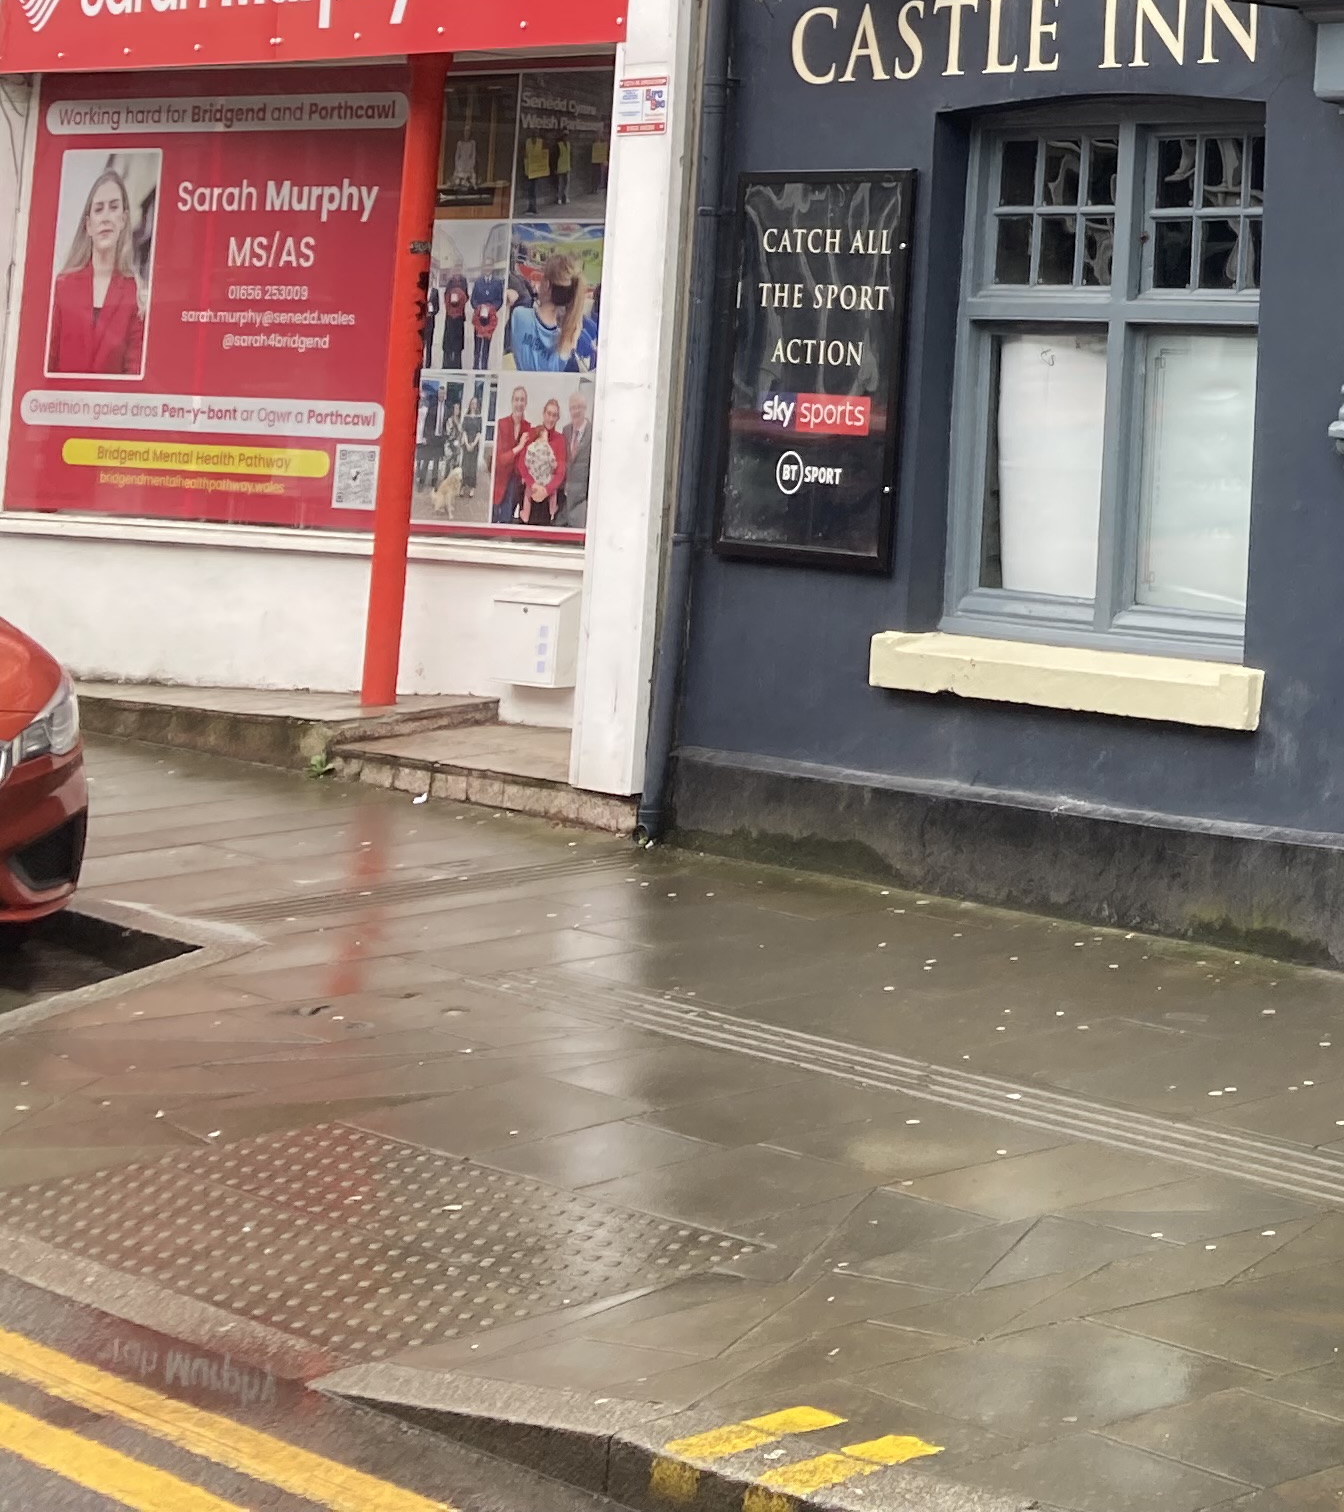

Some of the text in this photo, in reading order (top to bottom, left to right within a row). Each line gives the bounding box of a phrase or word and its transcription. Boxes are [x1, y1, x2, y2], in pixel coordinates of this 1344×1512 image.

[59, 100, 396, 130] Working hard for Bridgend and Porthcawl
[177, 178, 379, 222] Sarah Murphy
[227, 231, 315, 267] MS/AS
[763, 228, 892, 255] CATCH ALL
[228, 286, 261, 300] 01656
[758, 283, 889, 311] THE SPORT
[771, 338, 864, 366] ACTION
[161, 404, 237, 424] Pen-y-bont
[240, 409, 254, 421] ar
[257, 408, 291, 427] Ogwr
[295, 412, 303, 423] a
[307, 410, 376, 427] Porthcawl
[762, 394, 865, 428] sky sports
[97, 445, 291, 472] Bridgend Mental Health Pathway
[804, 466, 842, 485] SPORT
